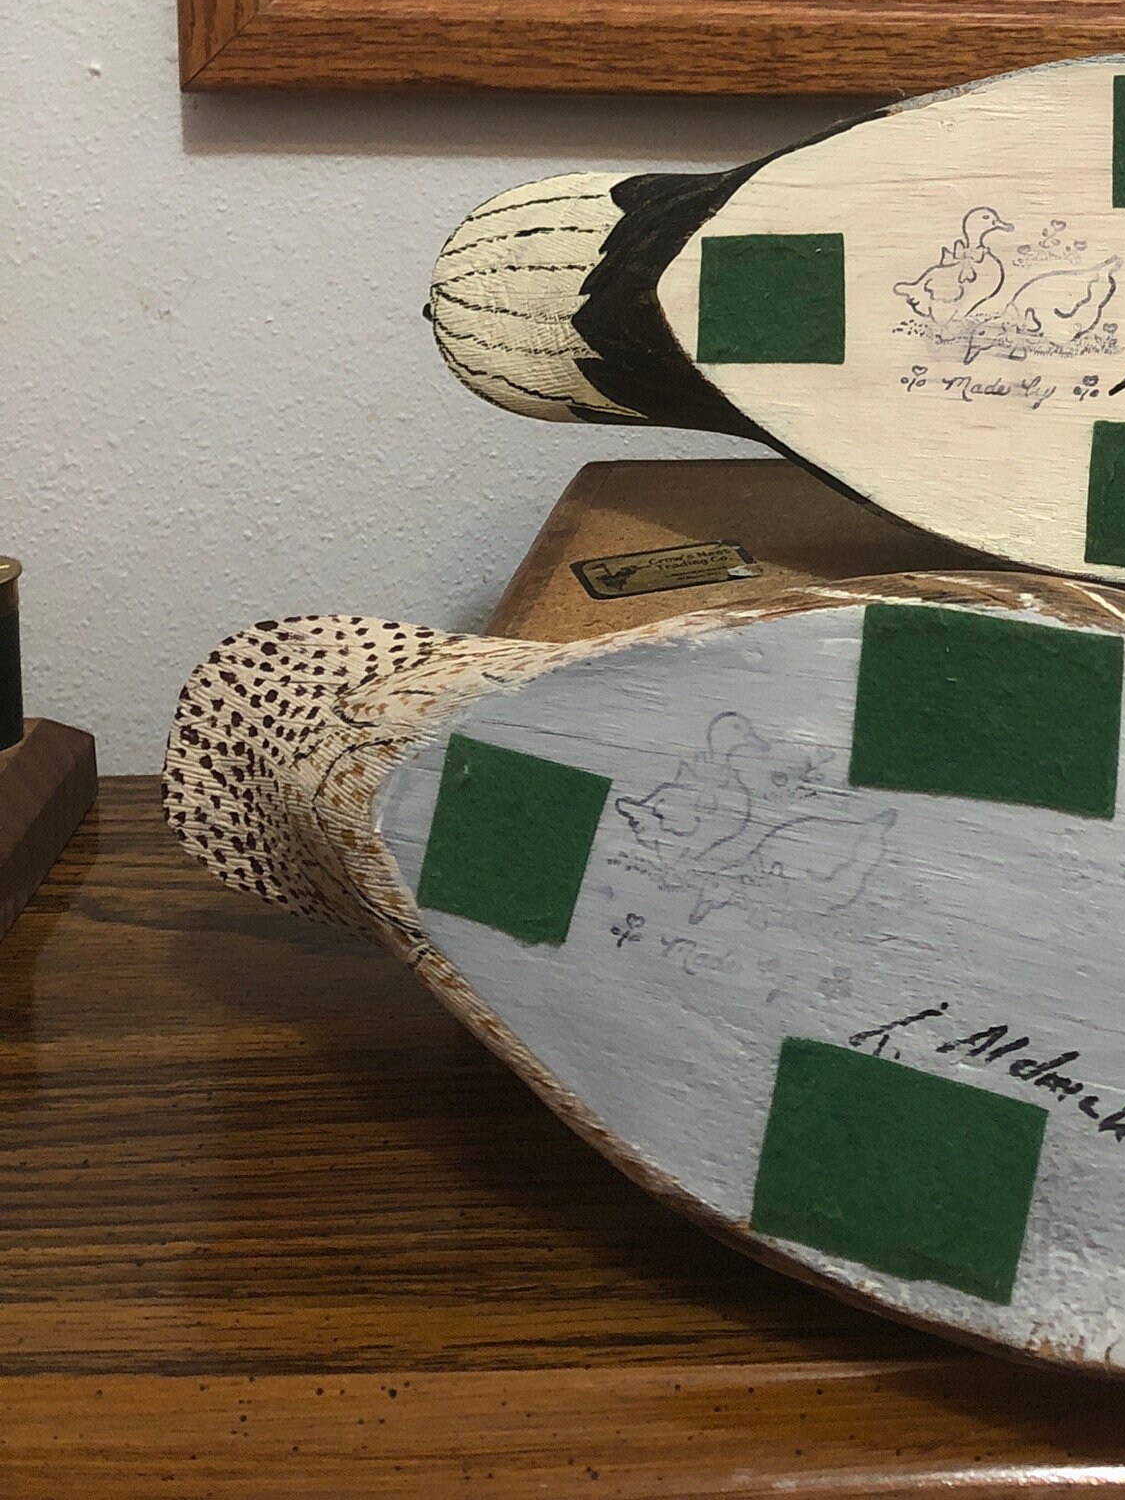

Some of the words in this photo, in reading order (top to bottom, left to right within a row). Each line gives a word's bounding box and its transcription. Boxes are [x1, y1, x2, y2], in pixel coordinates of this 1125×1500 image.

[941, 375, 1012, 402] Made
[1020, 375, 1057, 410] by
[657, 559, 709, 570] Trading
